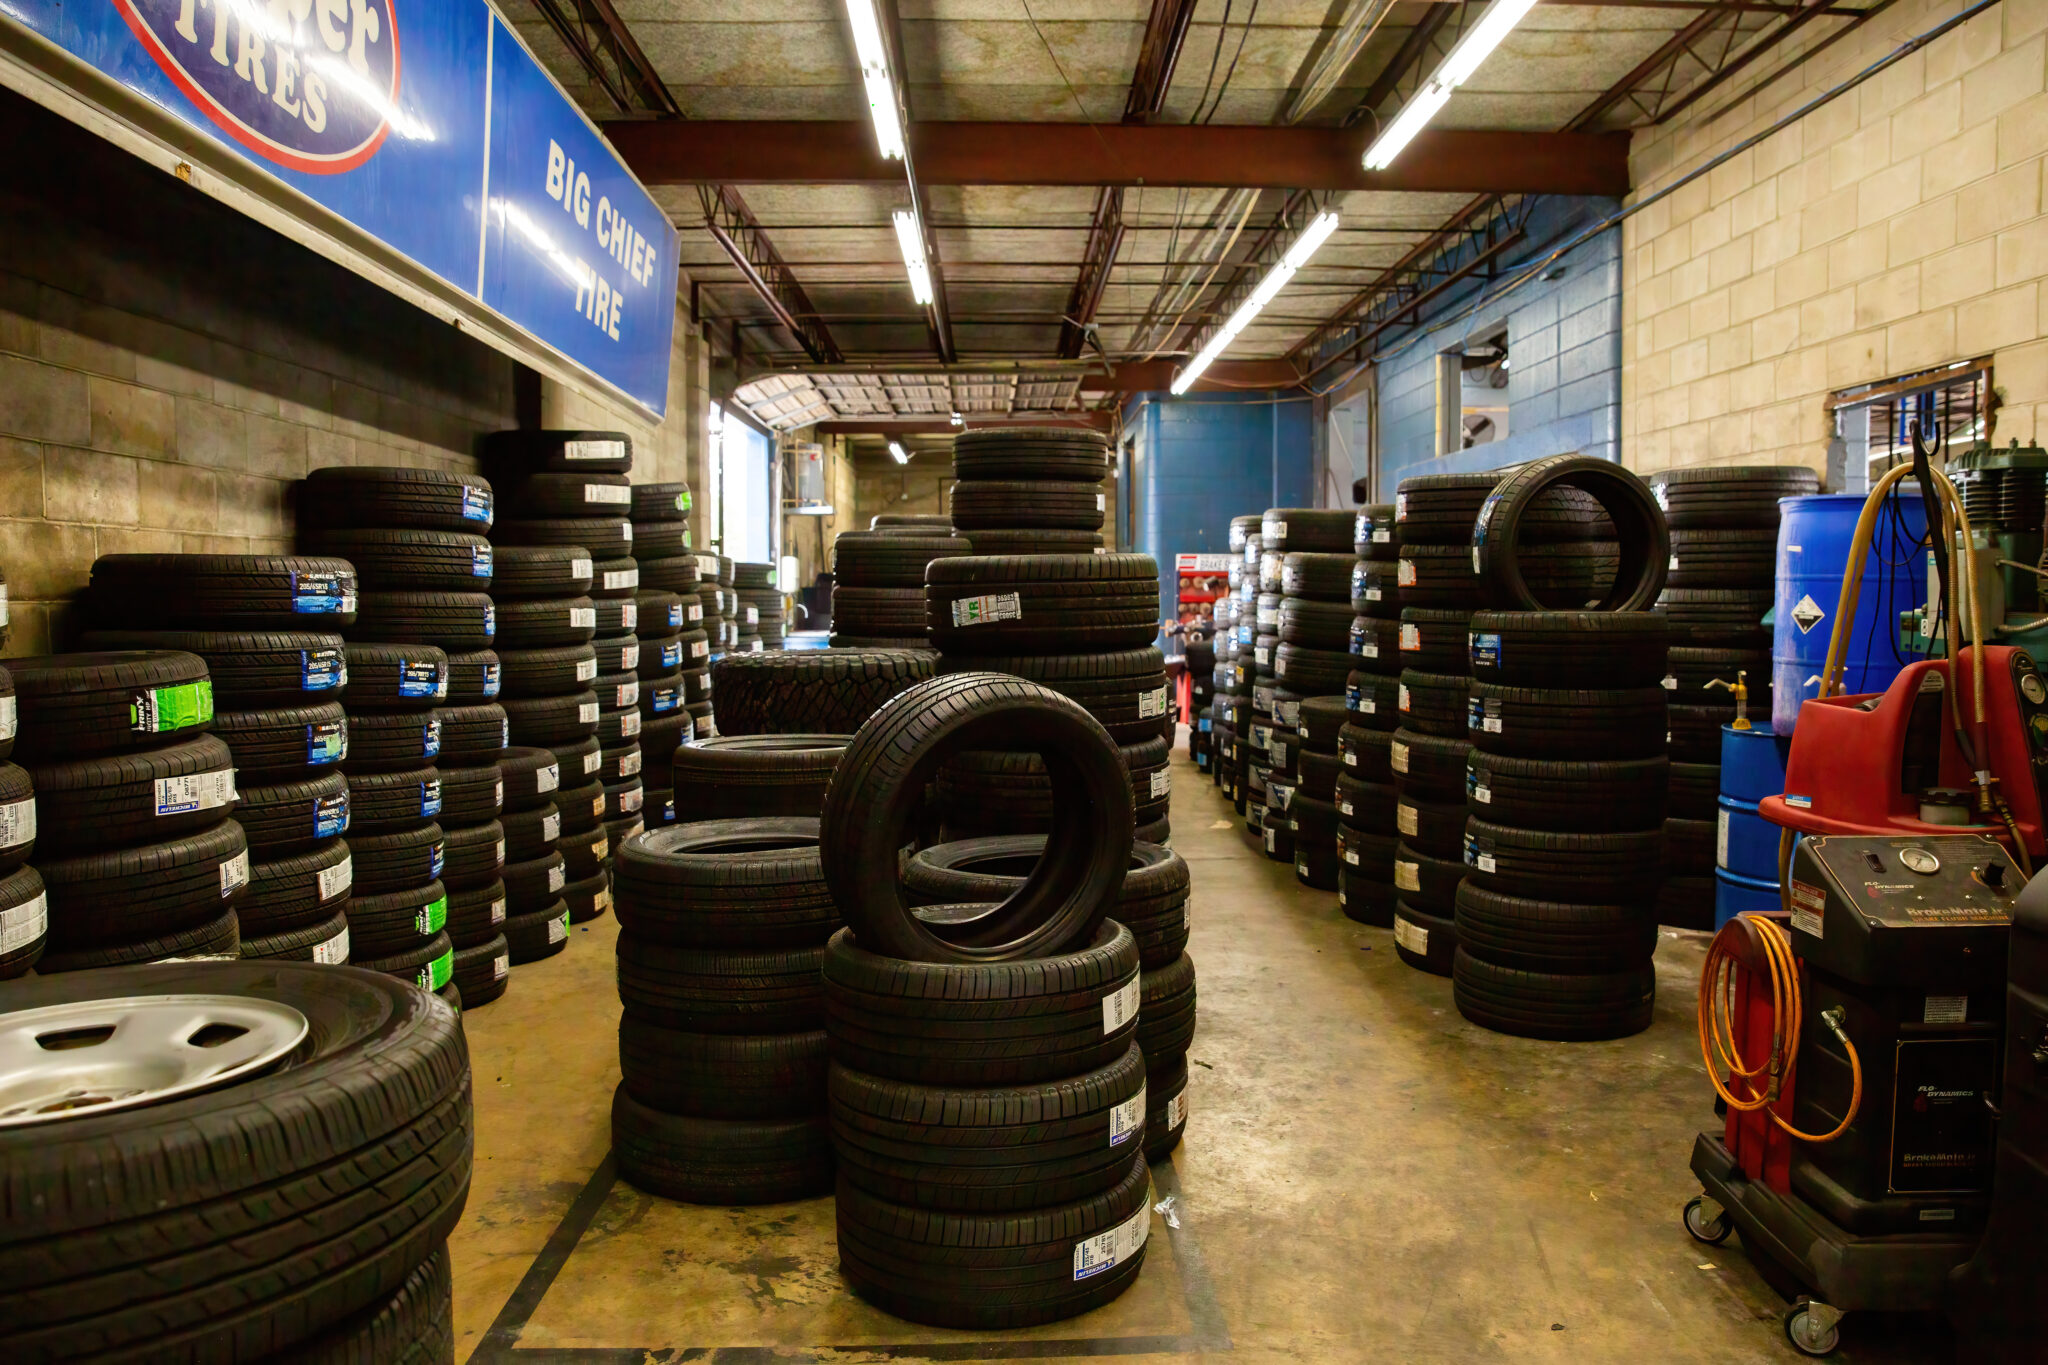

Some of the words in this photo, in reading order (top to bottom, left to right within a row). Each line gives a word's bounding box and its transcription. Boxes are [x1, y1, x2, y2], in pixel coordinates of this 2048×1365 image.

[174, 0, 327, 133] TIRES
[546, 138, 591, 230] BIG
[597, 196, 656, 288] CHIEF
[575, 256, 623, 342] TIRE
[1077, 1263, 1107, 1278] MICHELIN
